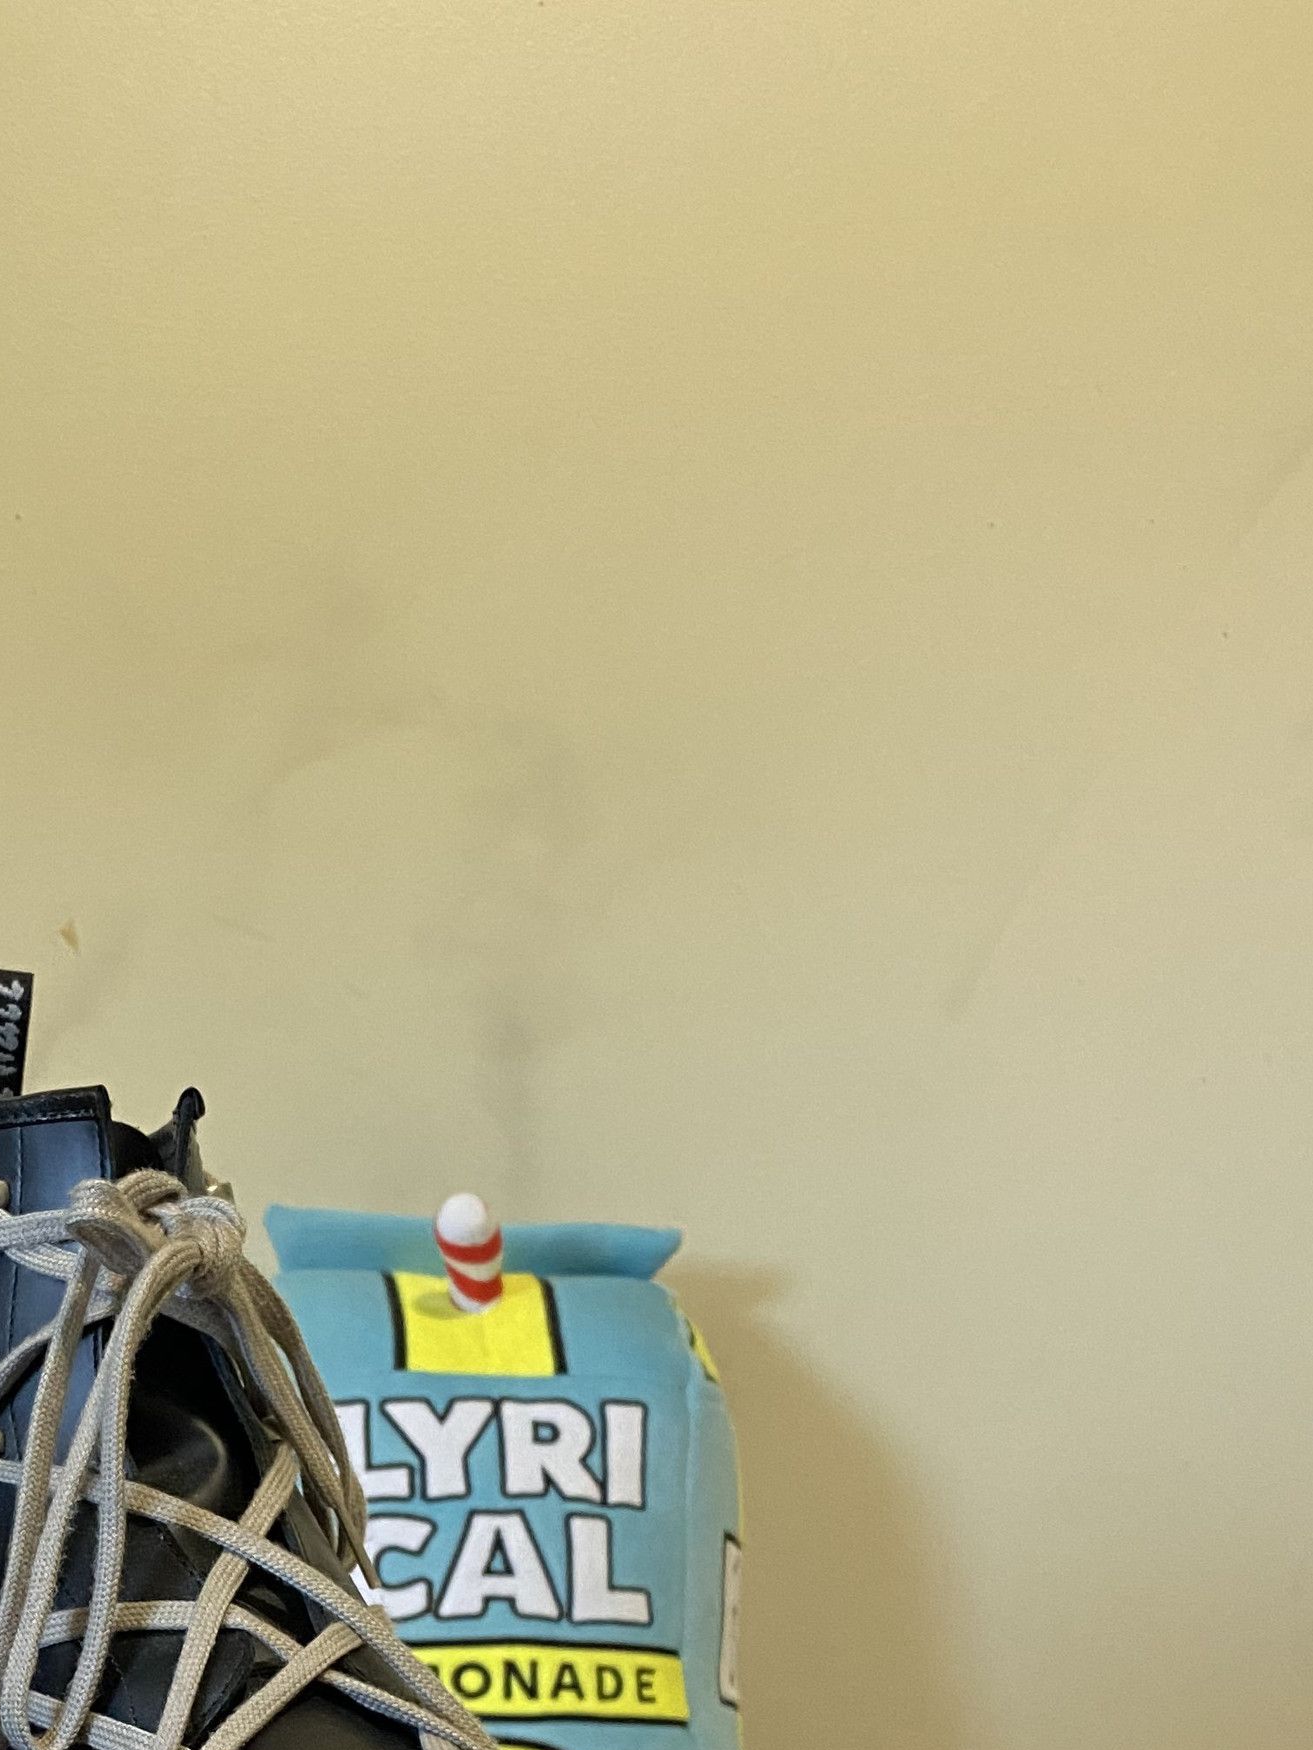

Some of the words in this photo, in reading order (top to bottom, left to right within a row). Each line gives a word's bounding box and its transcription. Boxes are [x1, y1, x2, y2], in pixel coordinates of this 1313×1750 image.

[335, 1396, 648, 1511] LYRI
[348, 1509, 654, 1627] CAL
[436, 1658, 658, 1705] ONADE
